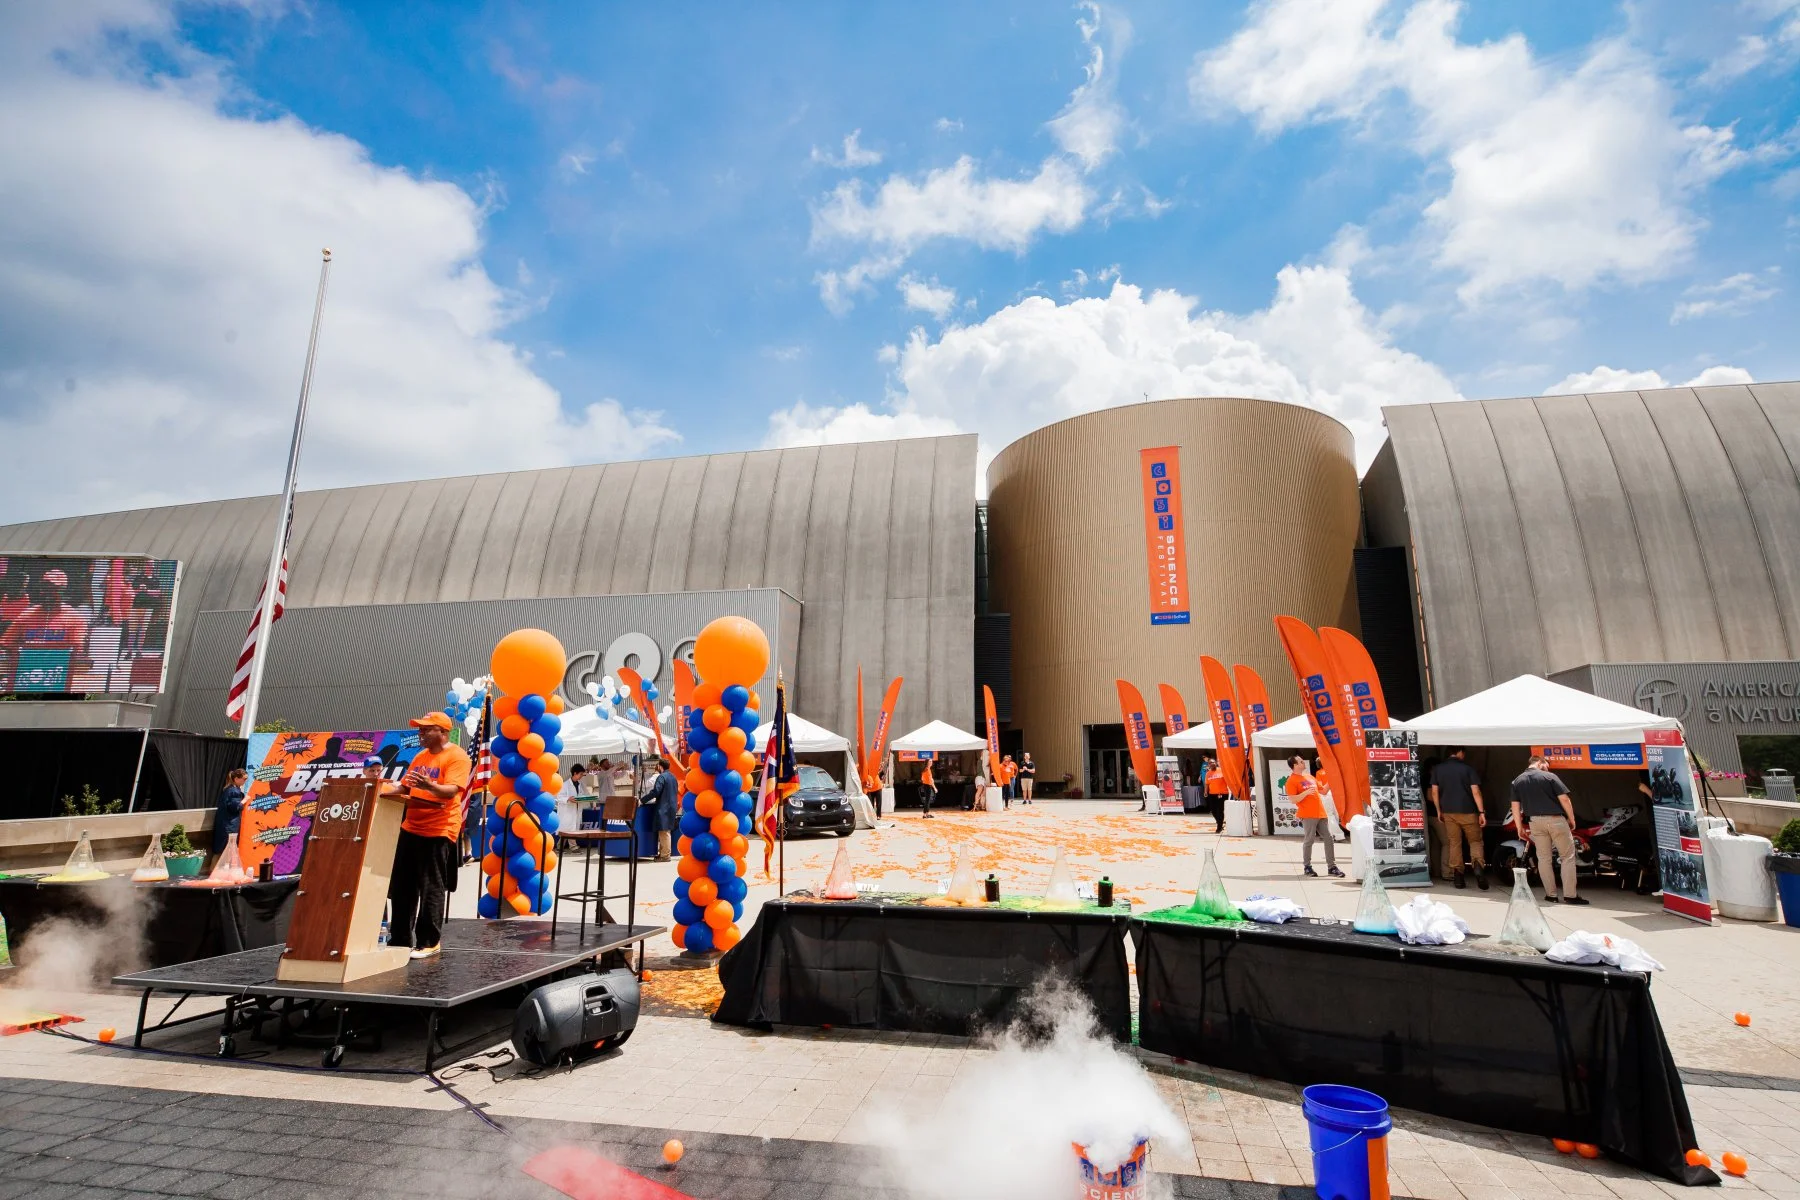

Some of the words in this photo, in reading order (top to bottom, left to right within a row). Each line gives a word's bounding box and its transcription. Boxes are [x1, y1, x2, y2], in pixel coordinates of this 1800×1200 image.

[1157, 536, 1168, 606] FESTIVAL
[1166, 535, 1178, 606] SCIENCE
[1344, 684, 1363, 747] SCIENCE
[1702, 680, 1800, 697] AMERIC
